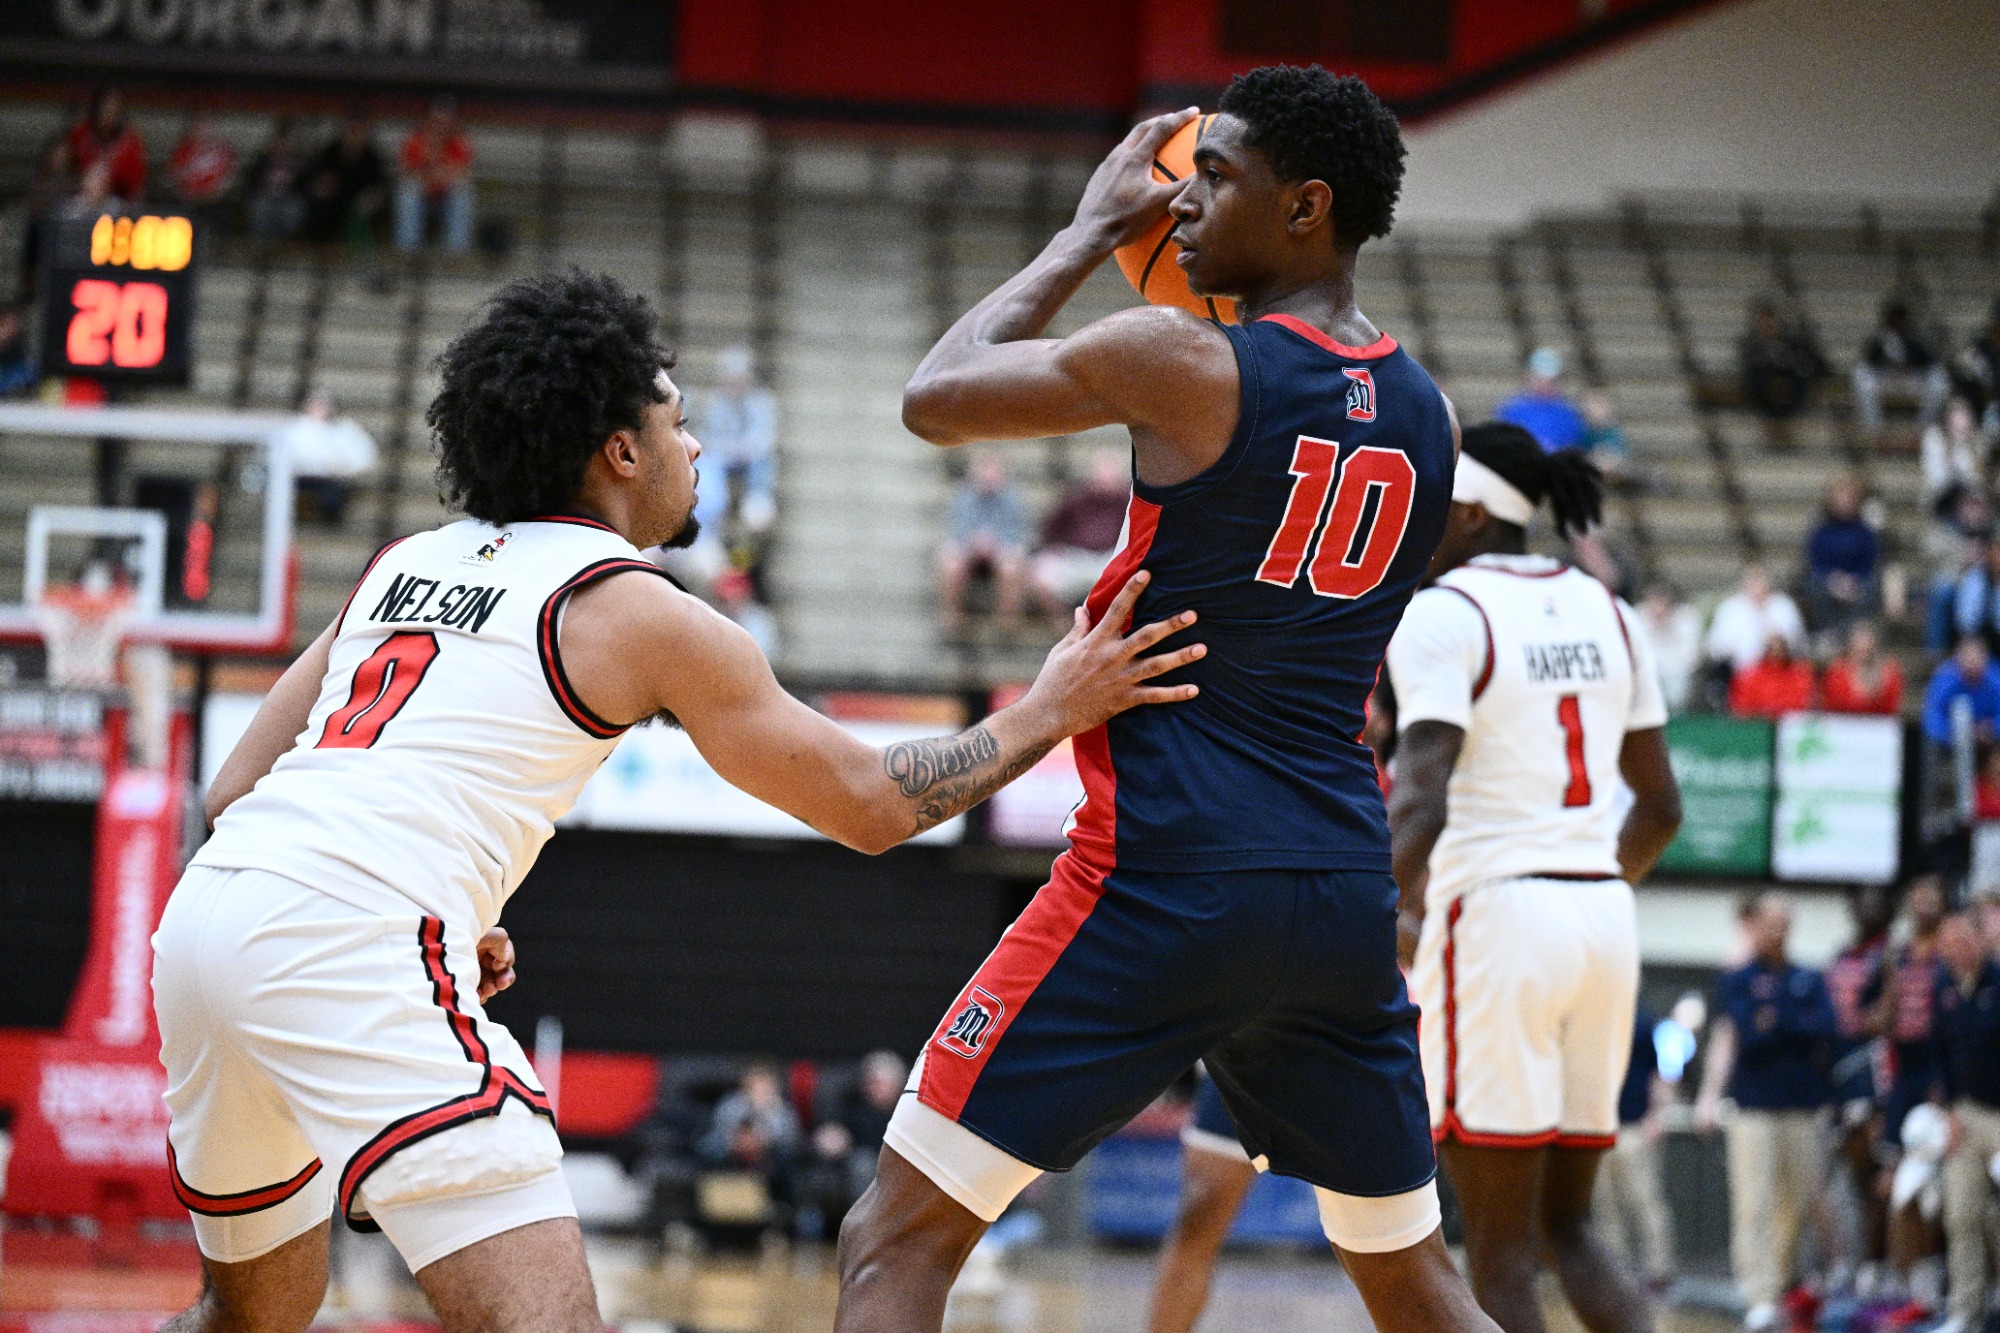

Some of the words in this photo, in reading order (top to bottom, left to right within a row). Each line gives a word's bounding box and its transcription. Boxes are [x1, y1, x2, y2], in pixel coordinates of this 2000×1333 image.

[66, 279, 168, 368] 20
[1255, 435, 1416, 600] 10
[368, 572, 507, 634] NELSON
[313, 630, 441, 749] 0
[1522, 638, 1607, 684] HARPER
[884, 727, 999, 797] Blessed
[1557, 692, 1592, 809] 1
